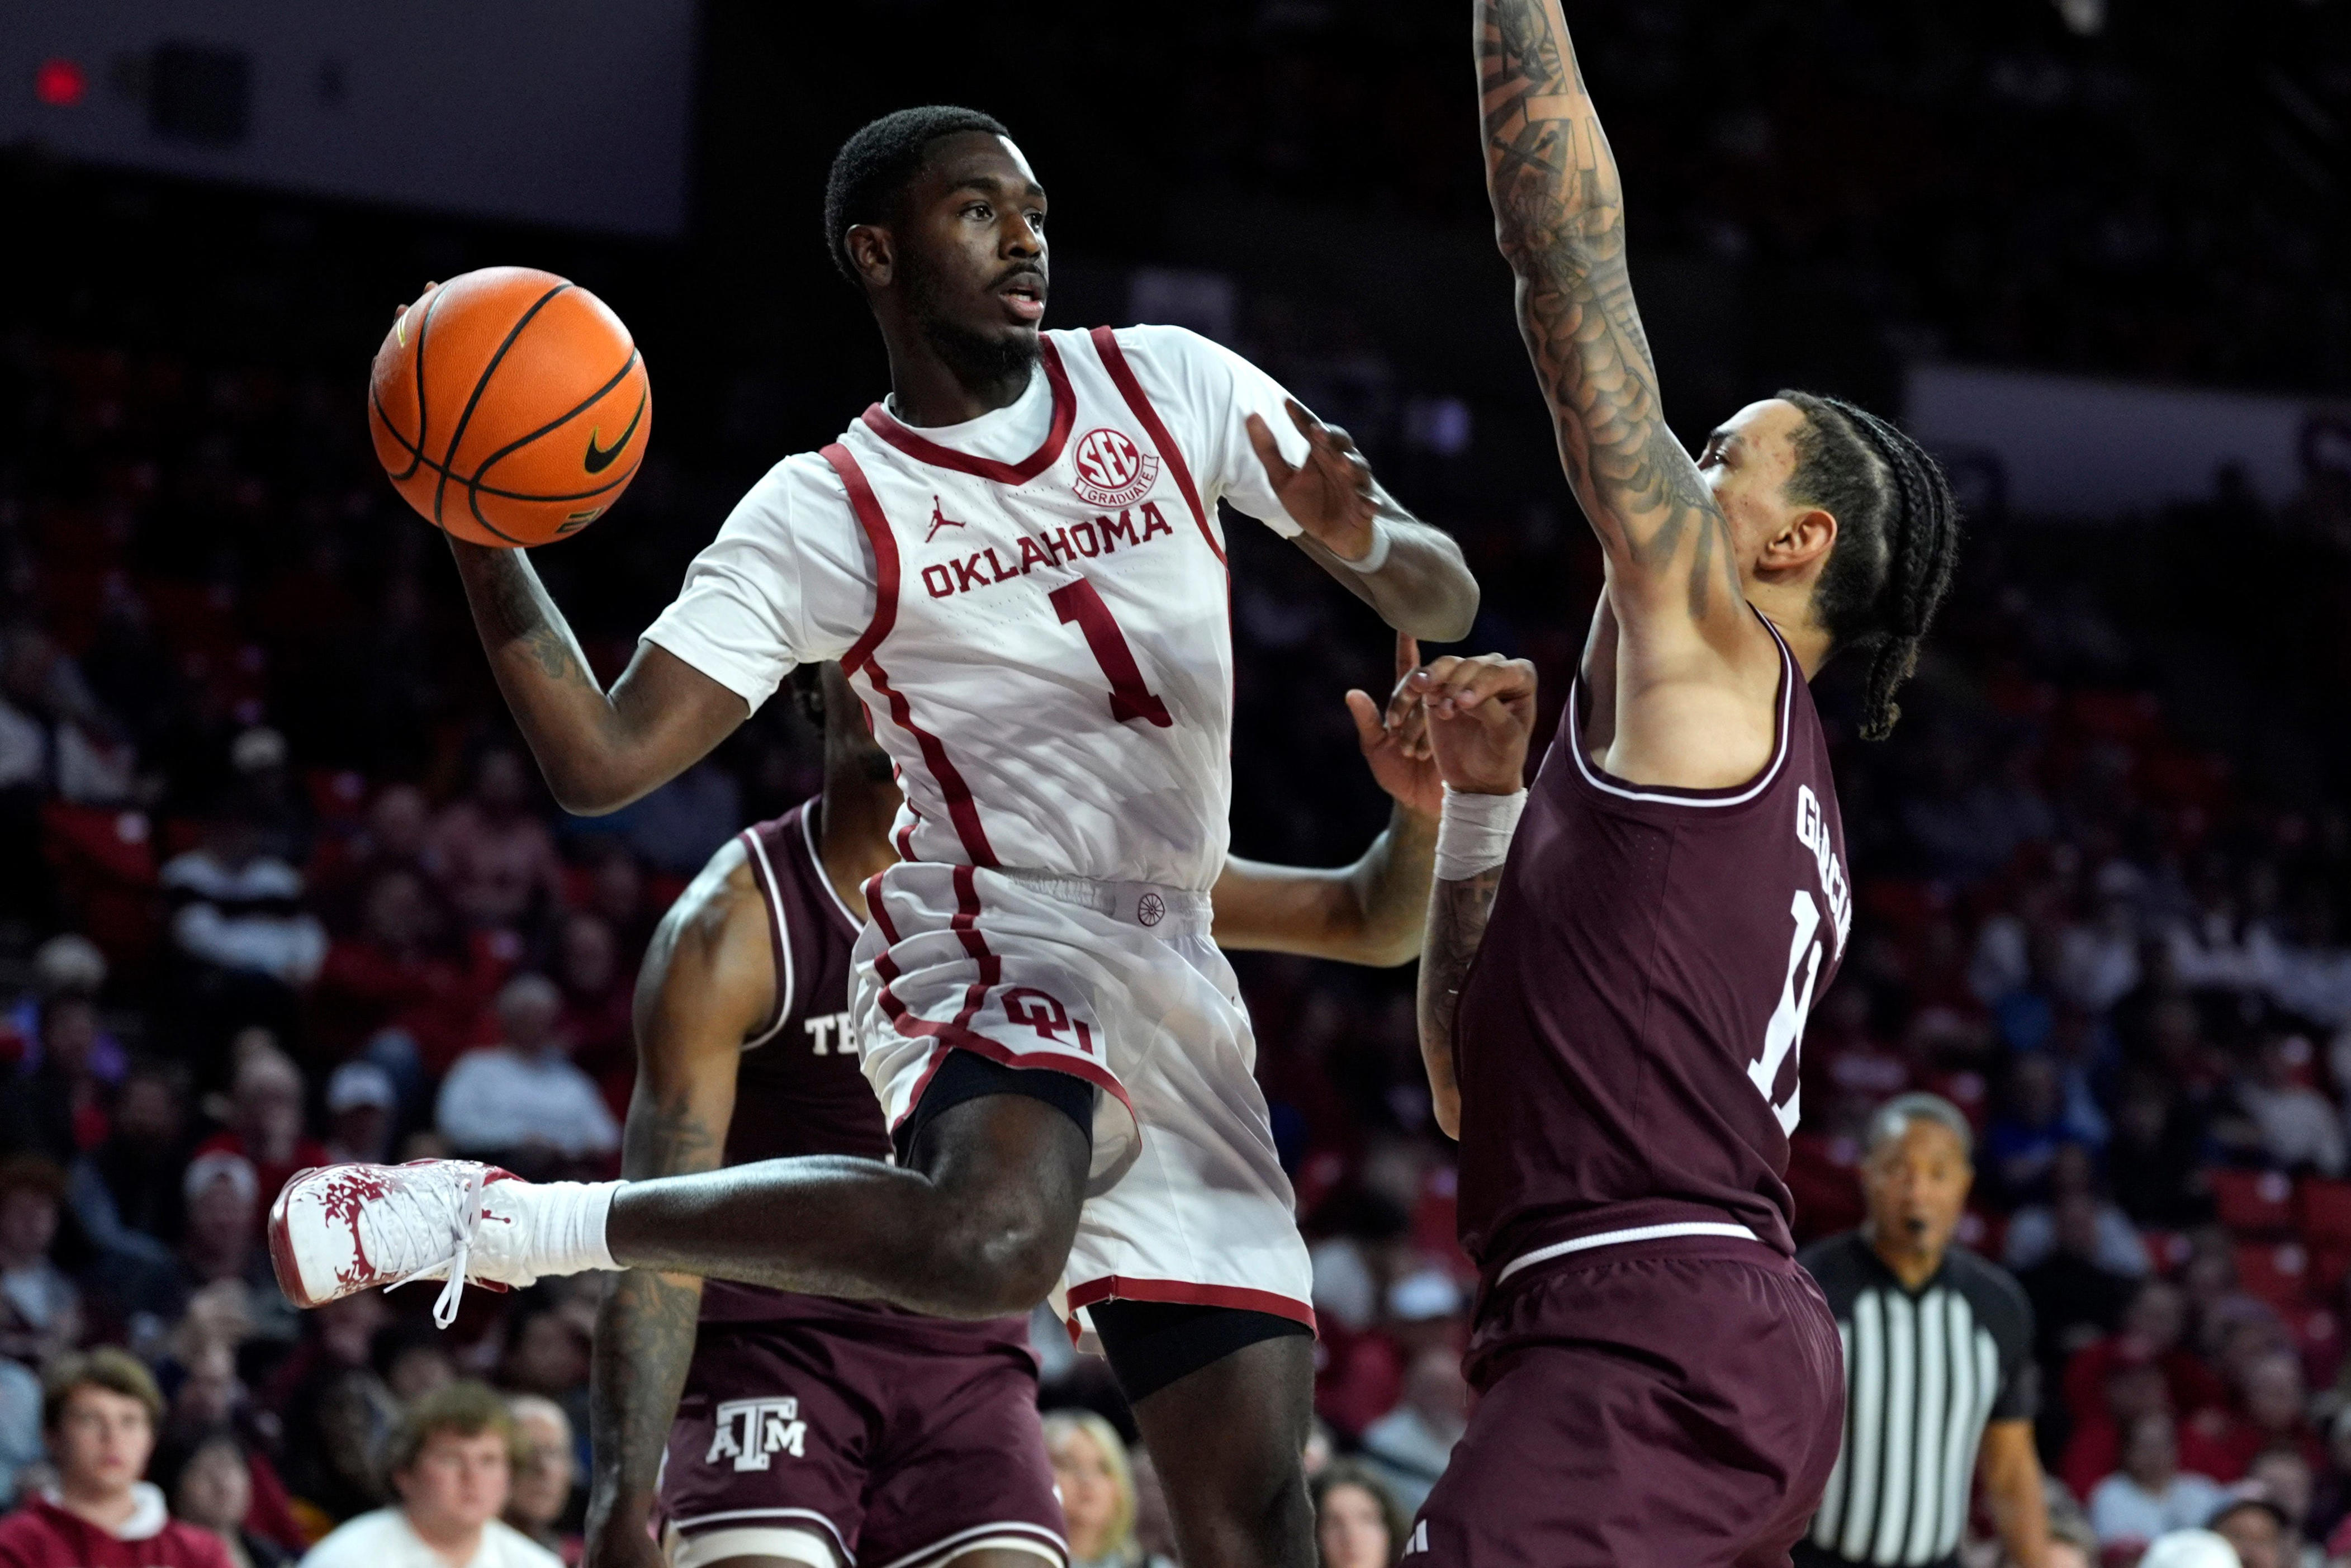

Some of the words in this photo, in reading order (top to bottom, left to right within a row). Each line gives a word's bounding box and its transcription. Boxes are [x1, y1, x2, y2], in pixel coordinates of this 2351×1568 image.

[1079, 430, 1137, 487] SEC
[1088, 472, 1153, 504] GRADUATE
[921, 501, 1173, 598] OKLAHOMA
[1049, 578, 1173, 727] 1
[805, 1012, 858, 1055] TE
[1001, 987, 1094, 1055] OU
